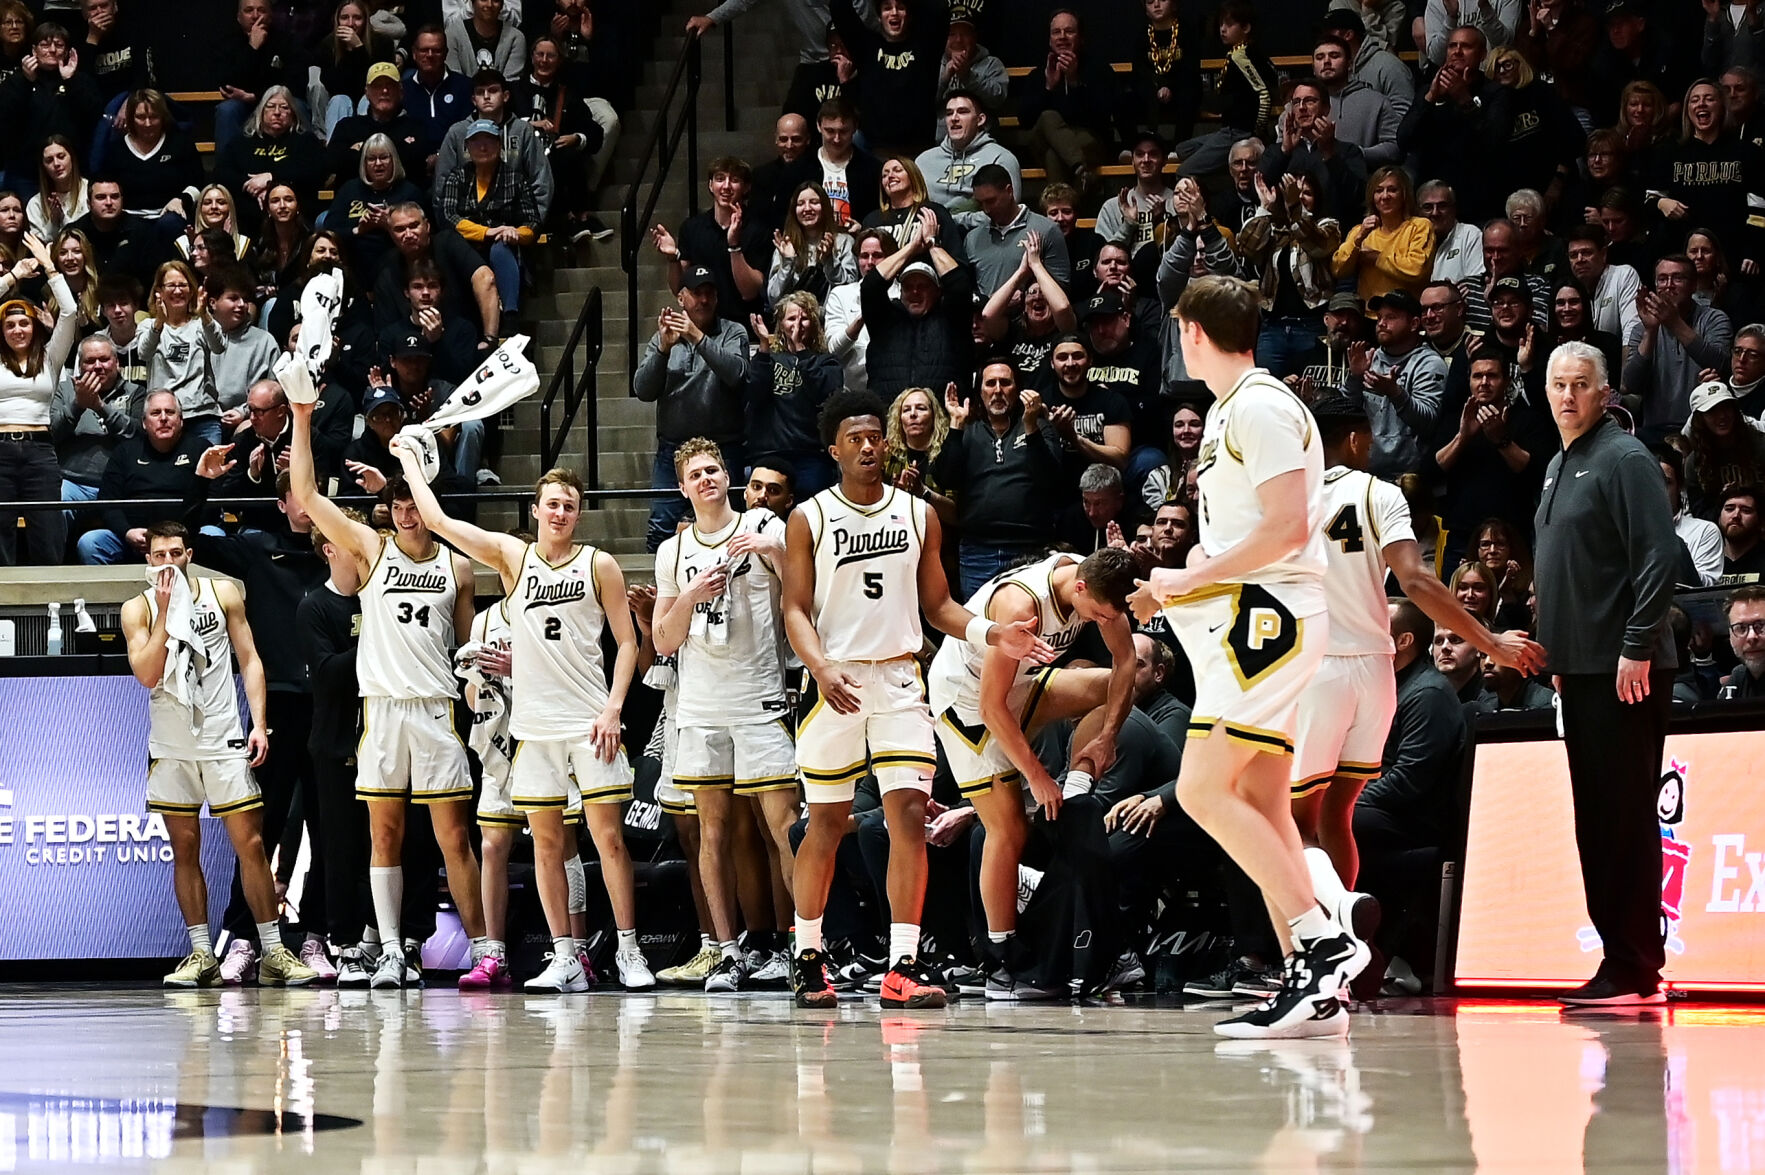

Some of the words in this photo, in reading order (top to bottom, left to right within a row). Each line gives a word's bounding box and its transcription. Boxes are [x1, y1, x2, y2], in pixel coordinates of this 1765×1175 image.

[1673, 161, 1743, 183] PURDUE
[1324, 503, 1365, 553] 4
[833, 528, 910, 568] Purdue
[384, 566, 446, 594] Purdue
[525, 574, 586, 610] Purdue
[863, 572, 882, 600] 5
[397, 602, 430, 632] 34
[545, 617, 561, 640] 2
[1247, 608, 1282, 650] P
[25, 814, 169, 844] FEDERA
[26, 847, 106, 864] CREDIT
[116, 844, 174, 863] UNIO
